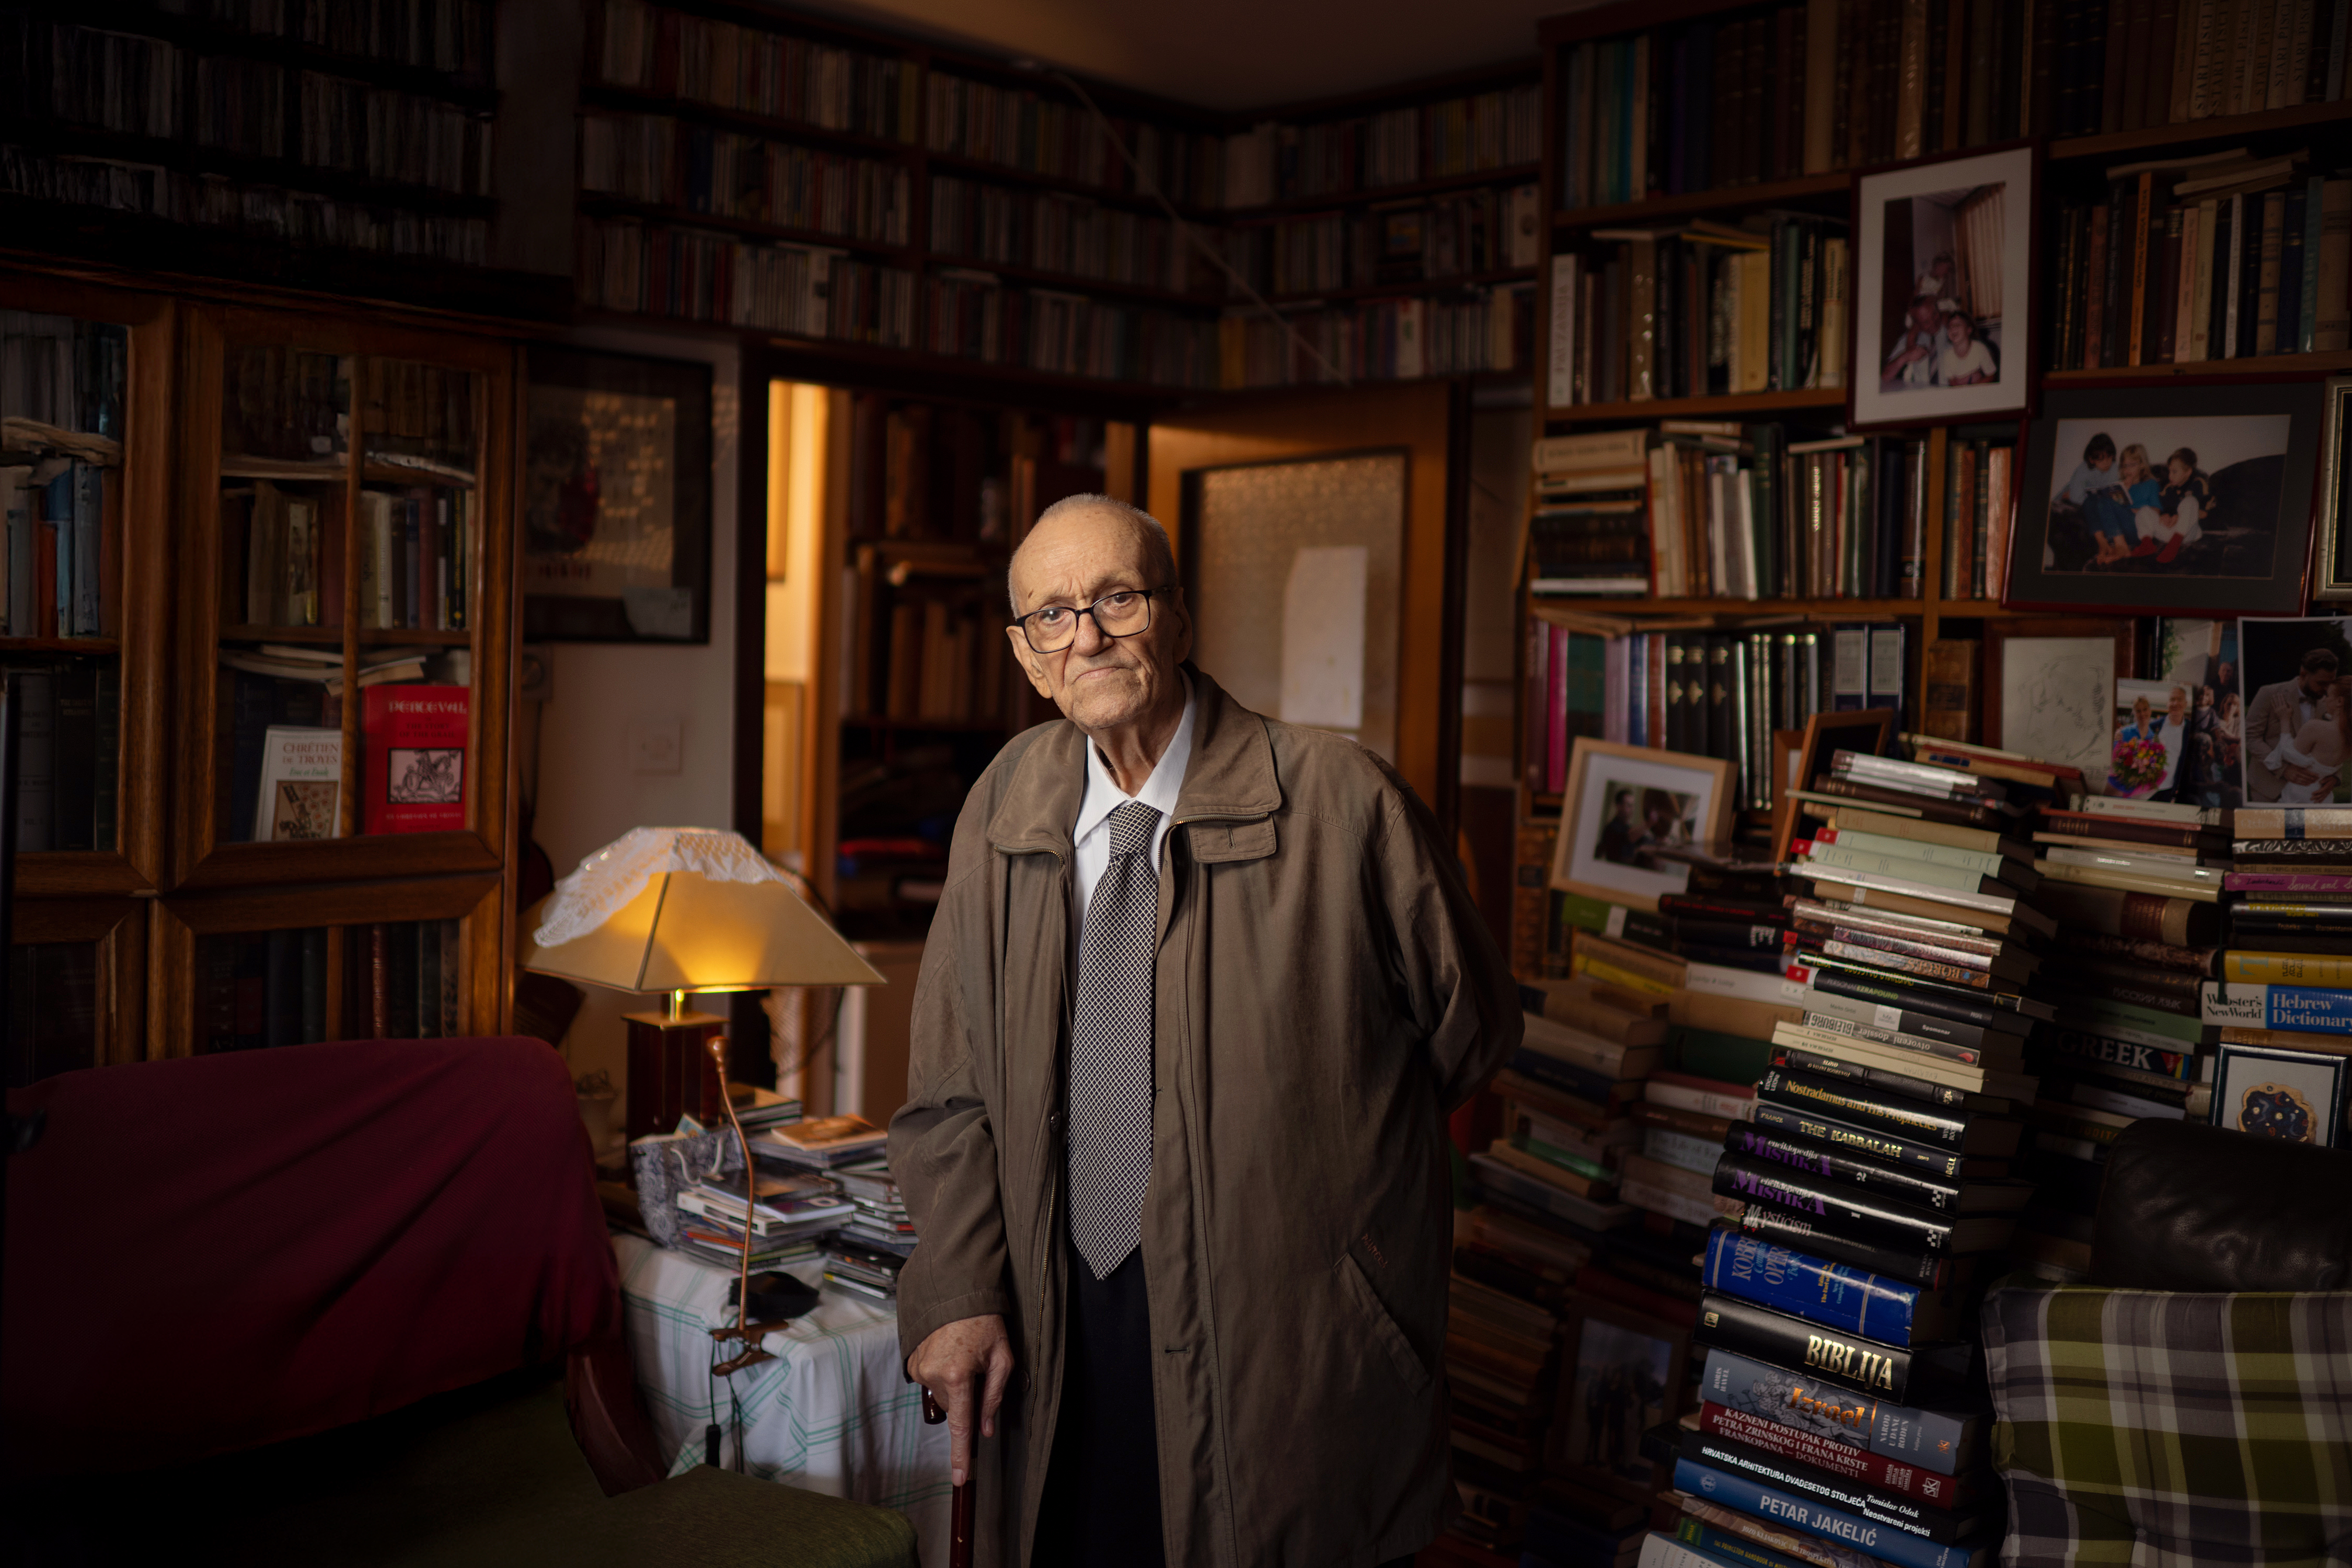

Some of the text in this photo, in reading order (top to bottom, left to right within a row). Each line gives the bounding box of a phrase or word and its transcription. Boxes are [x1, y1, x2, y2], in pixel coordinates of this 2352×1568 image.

[2207, 993, 2262, 1007] Wbster's
[2273, 993, 2334, 1010] Hebrew
[1811, 1012, 1853, 1034] BLEIBURG
[2057, 1031, 2154, 1071] GREEK
[1785, 1079, 1846, 1106] Nostradamus
[1847, 1100, 1867, 1112] and
[1800, 1120, 1827, 1138] THE
[1830, 1129, 1903, 1158] KABBALAH
[1804, 1334, 1893, 1390] BIBLIJA
[1788, 1387, 1865, 1428] Izrael
[1713, 1414, 1743, 1435] PETRA
[1745, 1424, 1794, 1449] ZRINSKOG
[1802, 1443, 1835, 1461] FRANA
[1836, 1455, 1869, 1472] KRSTE
[1719, 1427, 1859, 1478] FRANKOPANA DOKUMENTI
[1724, 1408, 1861, 1457] KAZNENI POSTUPAK PROTIV
[1702, 1446, 1866, 1508] HRVATSKA ARHITEKTURA DVADESETOG STOLJEĆA
[1759, 1495, 1877, 1547] PETAR JAKELIĆ
[1863, 1507, 1931, 1537] Neostvareni projekti
[1866, 1494, 1920, 1518] Tomislav Odak
